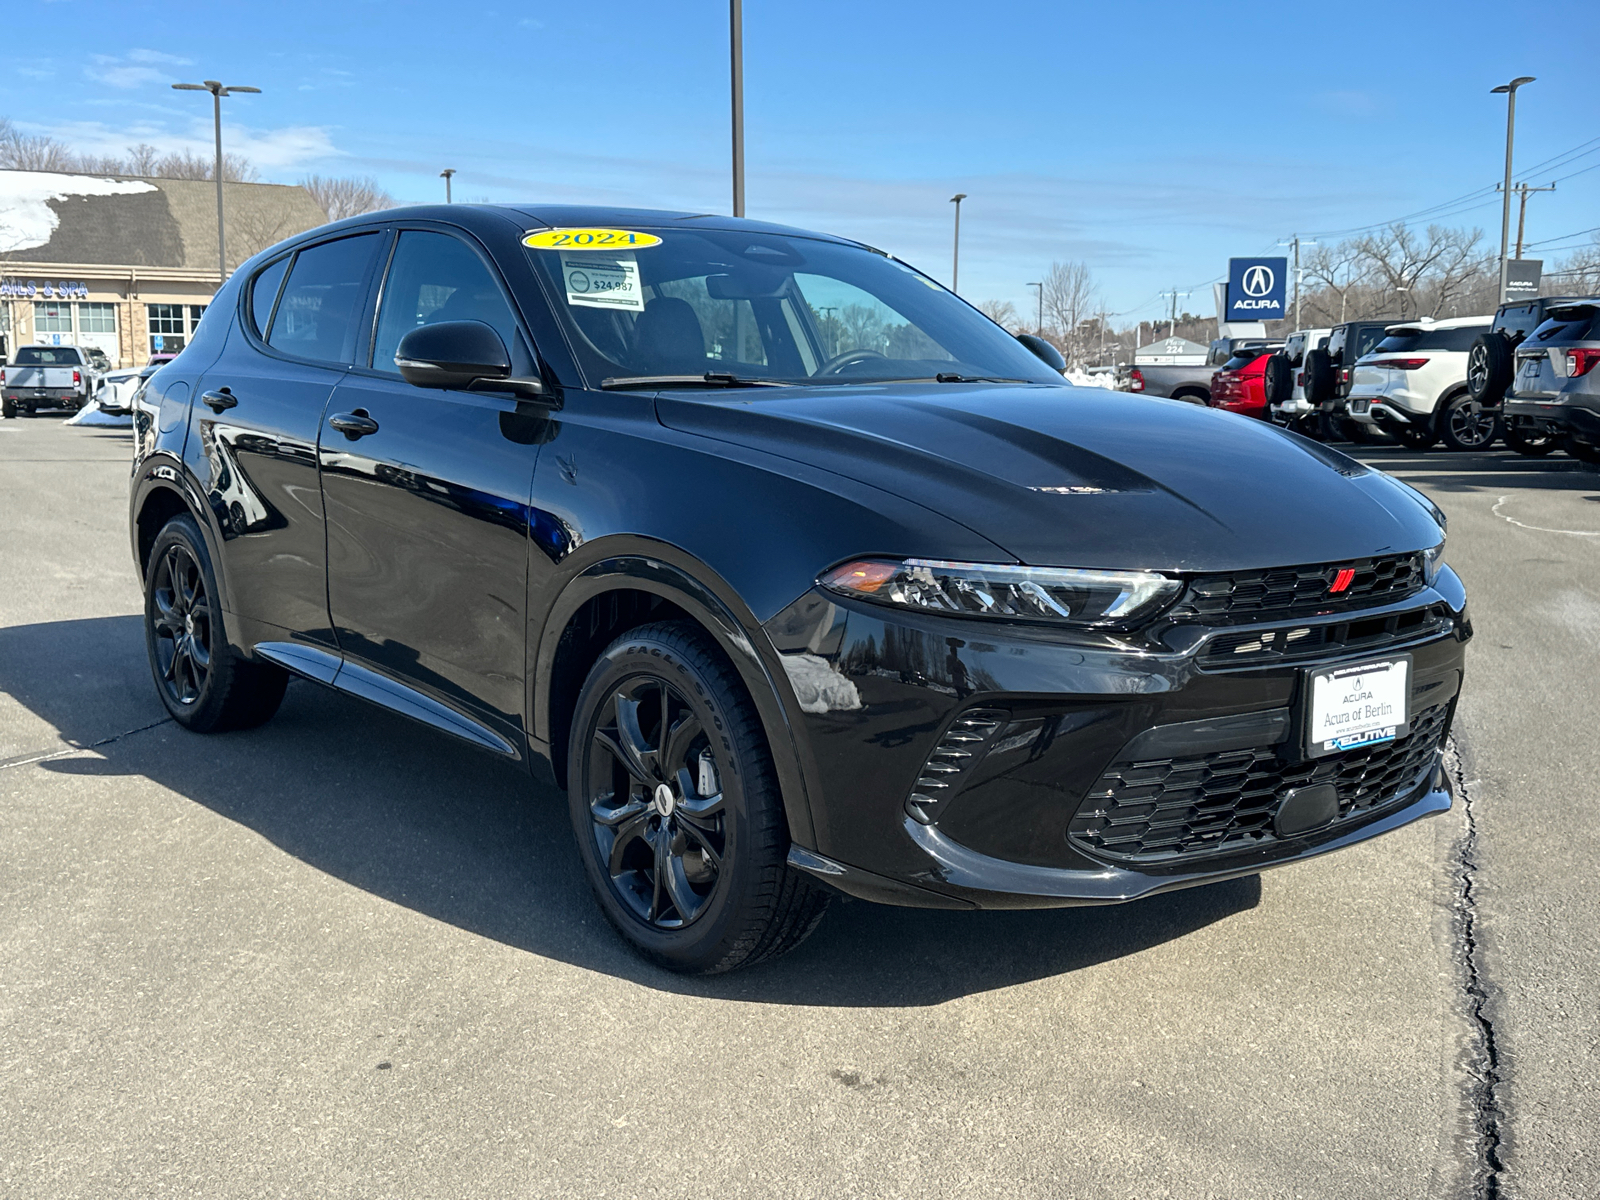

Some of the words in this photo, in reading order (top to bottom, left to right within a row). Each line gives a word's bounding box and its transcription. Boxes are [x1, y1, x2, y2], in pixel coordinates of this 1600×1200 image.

[552, 233, 640, 246] 2024
[44, 280, 55, 296] &
[59, 281, 89, 297] SPA
[593, 280, 633, 292] $24,987
[1233, 299, 1280, 309] ACURA
[1166, 345, 1184, 354] 224
[1342, 691, 1373, 704] ACURA
[626, 646, 689, 675] EAGLE
[694, 681, 738, 775] SPORT
[1324, 712, 1350, 727] Acura
[1352, 707, 1362, 721] of
[1364, 702, 1393, 719] Berlin
[1324, 726, 1397, 751] EXECUTIVE
